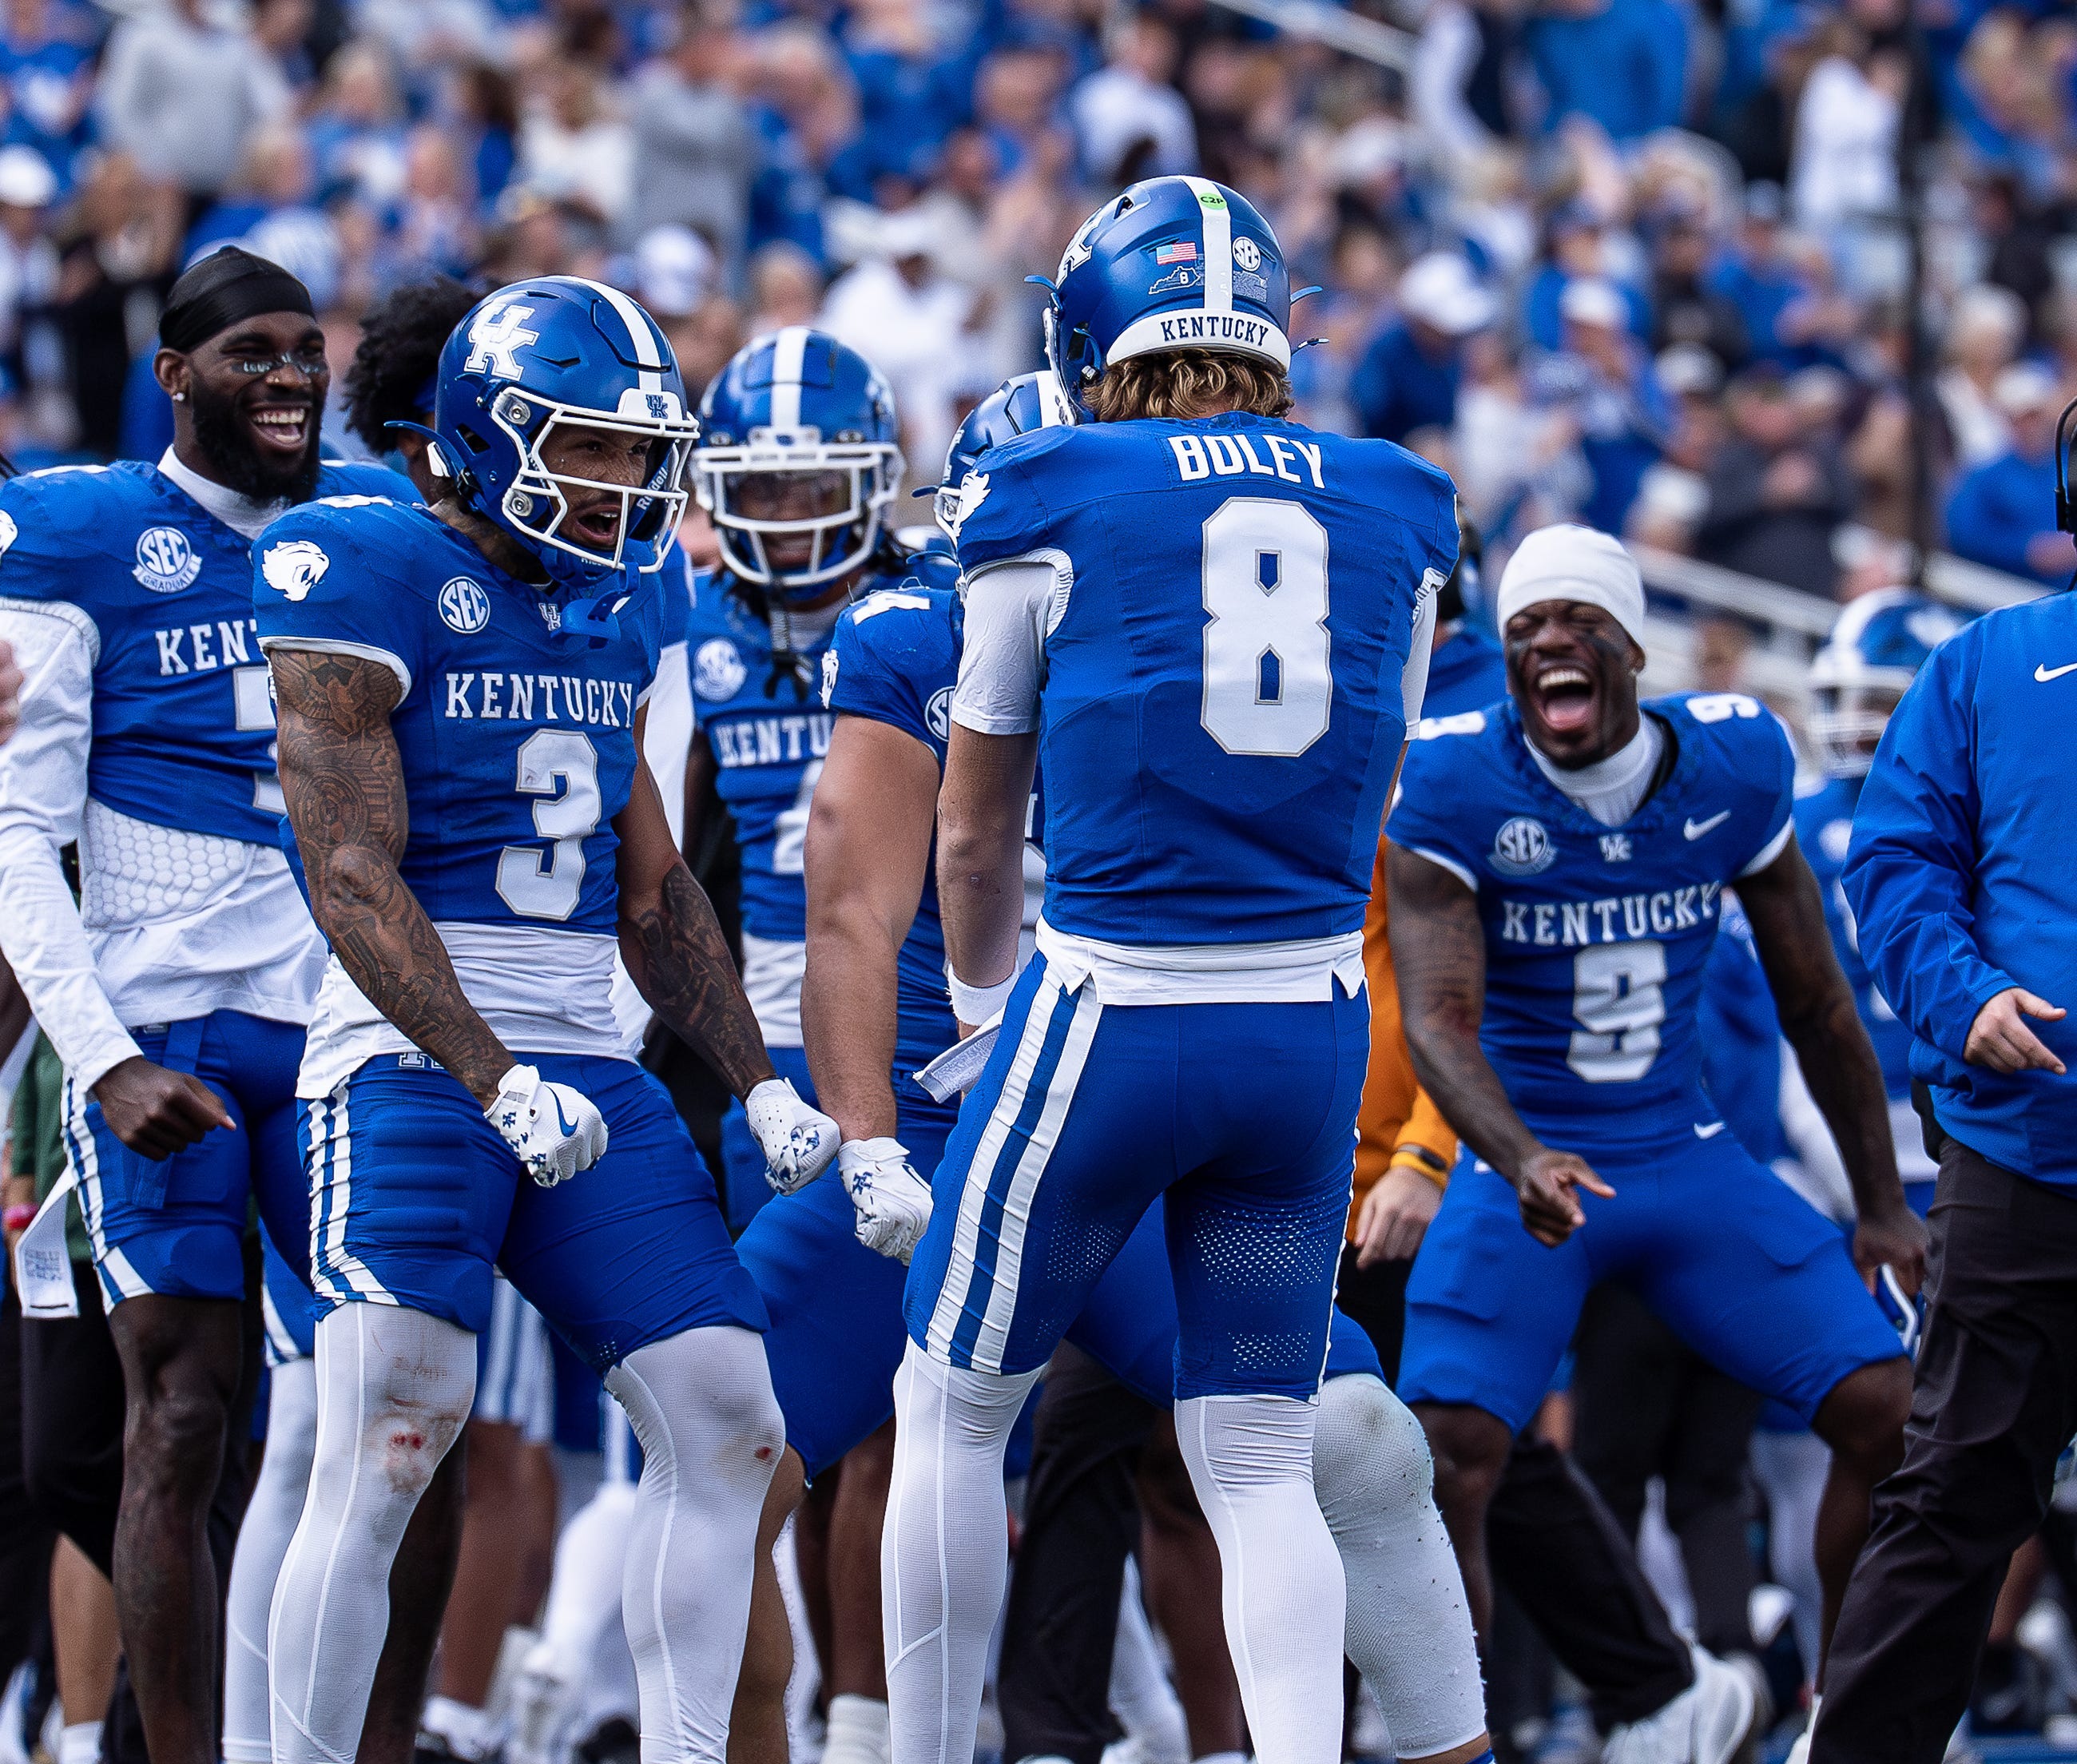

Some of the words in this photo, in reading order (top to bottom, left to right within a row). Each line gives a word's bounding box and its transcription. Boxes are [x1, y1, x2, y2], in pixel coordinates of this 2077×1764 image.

[1200, 196, 1224, 205] C2P
[1233, 238, 1260, 269] SEC
[1161, 316, 1269, 347] KENTUCKY
[1168, 435, 1325, 489] BOLEY
[636, 466, 668, 511] Ridell
[141, 529, 188, 576] SEC
[442, 580, 486, 630] SEC
[1200, 496, 1333, 757] 8
[445, 672, 633, 728] KENTUCKY
[494, 728, 602, 922] 3
[1499, 820, 1545, 862] SEC
[1503, 880, 1722, 946] KENTUCKY
[1566, 939, 1667, 1083] 9
